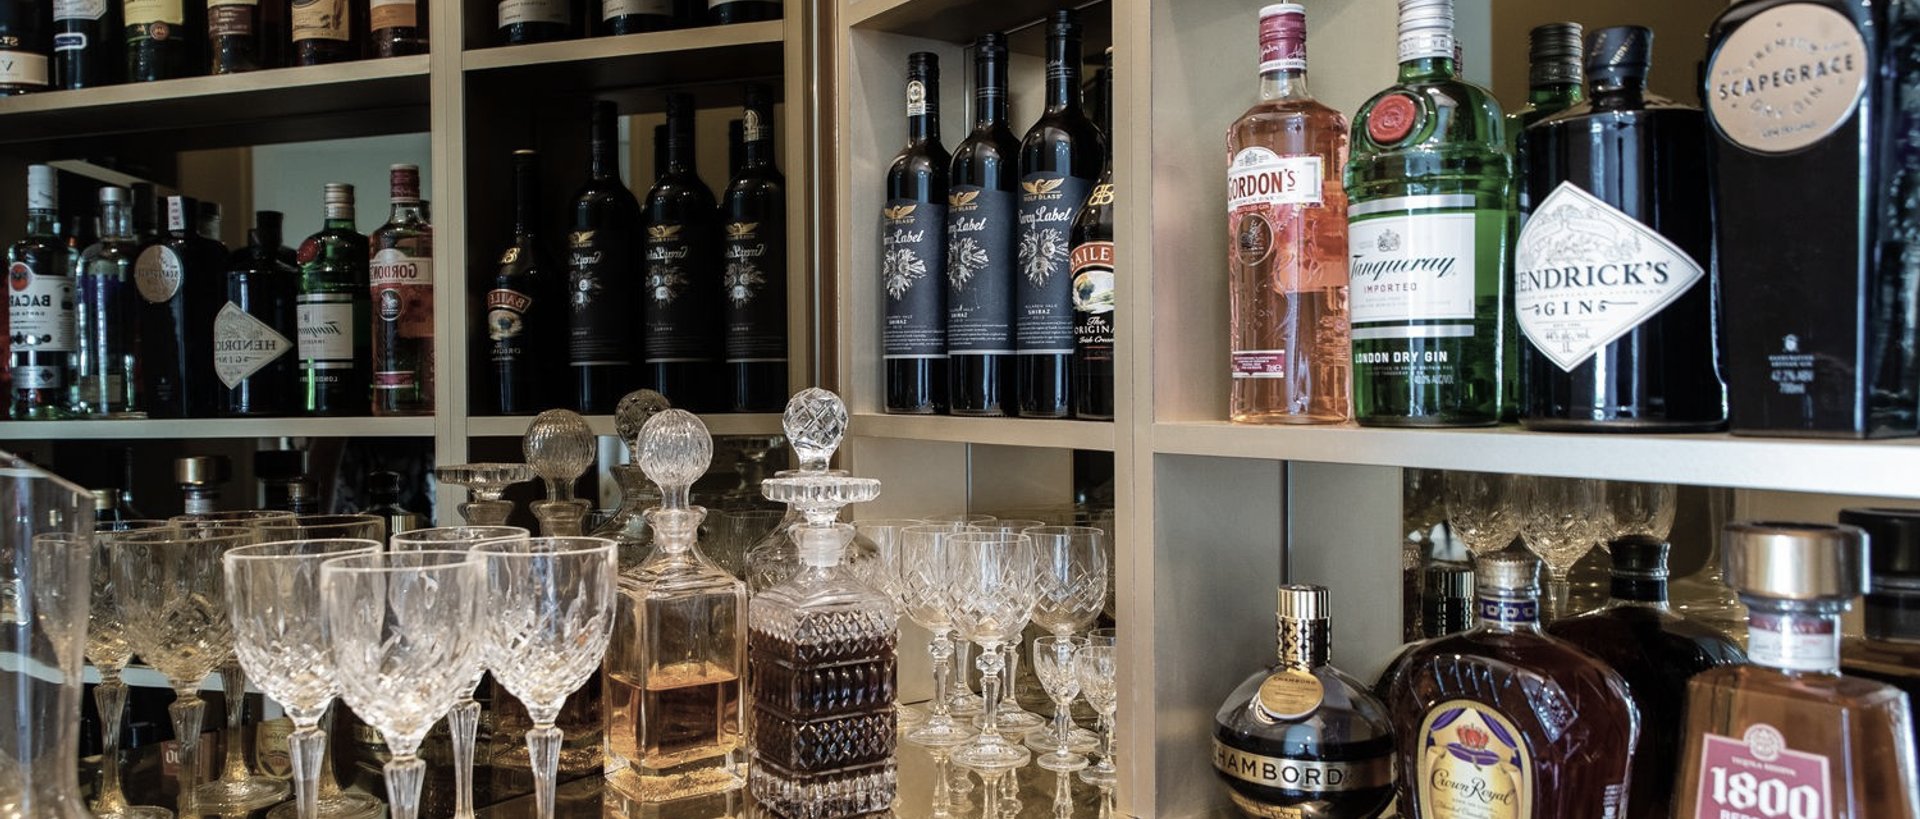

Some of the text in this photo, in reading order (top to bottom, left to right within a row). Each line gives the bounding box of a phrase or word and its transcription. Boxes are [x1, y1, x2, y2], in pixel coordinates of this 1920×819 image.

[1718, 54, 1854, 101] SCAPEGRACE
[1035, 205, 1073, 222] Label
[956, 216, 987, 233] Label
[893, 228, 925, 244] Label
[1350, 254, 1456, 281] Tanqueray
[1363, 282, 1418, 294] IMPORTED
[1544, 301, 1594, 317] GIN
[1355, 350, 1448, 363] LONDON DRY GIN
[1430, 767, 1470, 793] Crown
[1462, 775, 1517, 805] Royal
[1710, 766, 1820, 819] 1800
